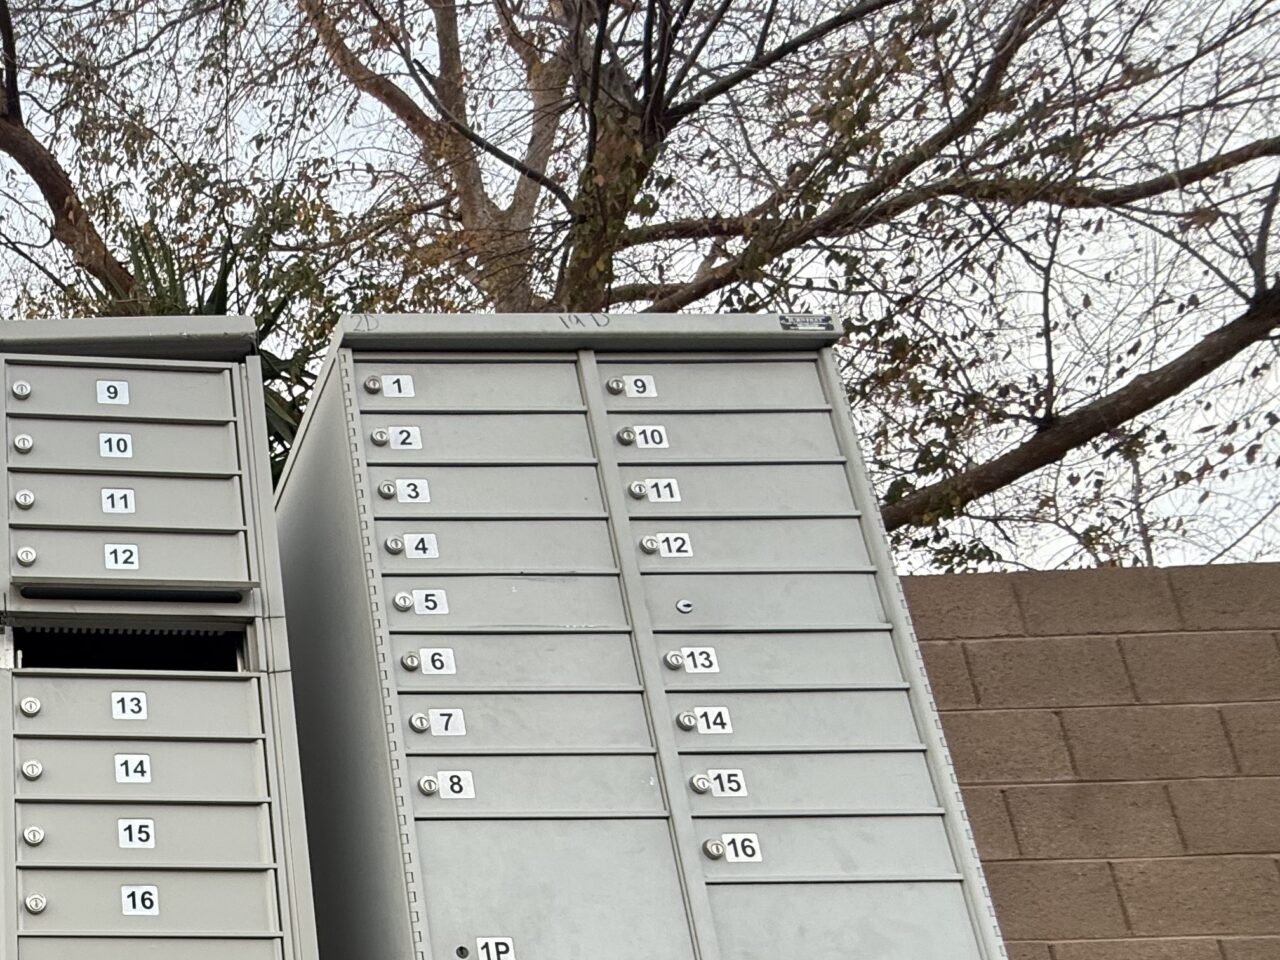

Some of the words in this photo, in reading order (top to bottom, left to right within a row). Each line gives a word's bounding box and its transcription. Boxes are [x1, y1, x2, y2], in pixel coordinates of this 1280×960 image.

[106, 384, 119, 400] 9
[392, 378, 402, 394] 1
[633, 378, 647, 394] 9
[104, 437, 128, 454] 10
[398, 429, 413, 446] 2
[638, 428, 664, 445] 10
[406, 482, 420, 500] 3
[650, 481, 675, 499] 11
[106, 493, 129, 509] 11
[414, 537, 429, 555] 4
[661, 536, 689, 554] 12
[109, 548, 135, 565] 12
[424, 593, 438, 611] 5
[430, 652, 445, 671] 6
[686, 650, 714, 669] 13
[116, 696, 143, 715] 13
[439, 712, 453, 732] 7
[699, 711, 727, 730] 14
[120, 759, 147, 778] 14
[449, 774, 464, 794] 8
[713, 773, 742, 793] 15
[123, 824, 151, 843] 15
[727, 837, 756, 858] 16
[126, 890, 155, 910] 16
